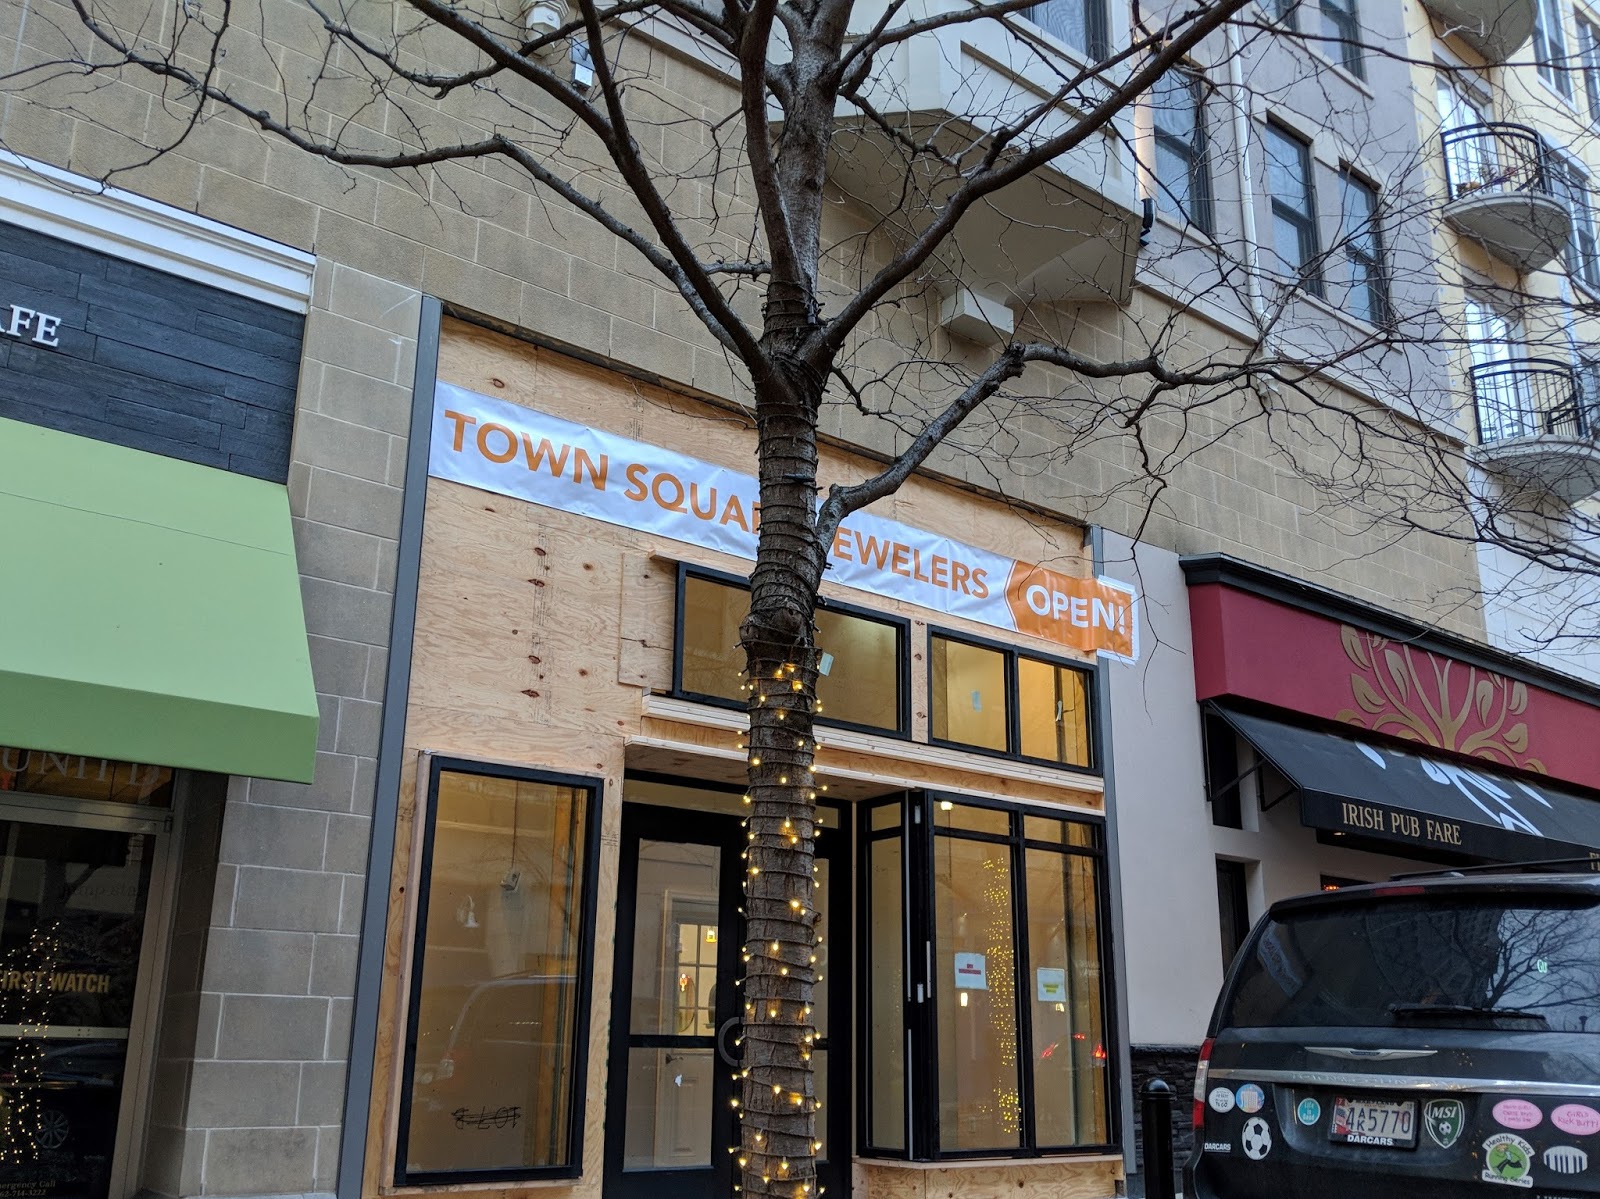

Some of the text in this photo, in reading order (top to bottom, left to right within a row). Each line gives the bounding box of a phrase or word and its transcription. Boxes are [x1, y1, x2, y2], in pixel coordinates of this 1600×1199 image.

[0, 304, 61, 347] FE
[444, 409, 609, 491] TOWN
[833, 526, 990, 599] EWELERS
[1025, 583, 1127, 636] OPEN!
[1341, 802, 1462, 846] IRISH PUB FARE
[0, 969, 110, 993] IRST WATCH
[1431, 1106, 1458, 1119] MSI
[1203, 1142, 1232, 1152] DARCARS
[1346, 1134, 1394, 1146] DARCARS
[1485, 1134, 1532, 1155] Healthy Kids
[1484, 1172, 1508, 1183] Running
